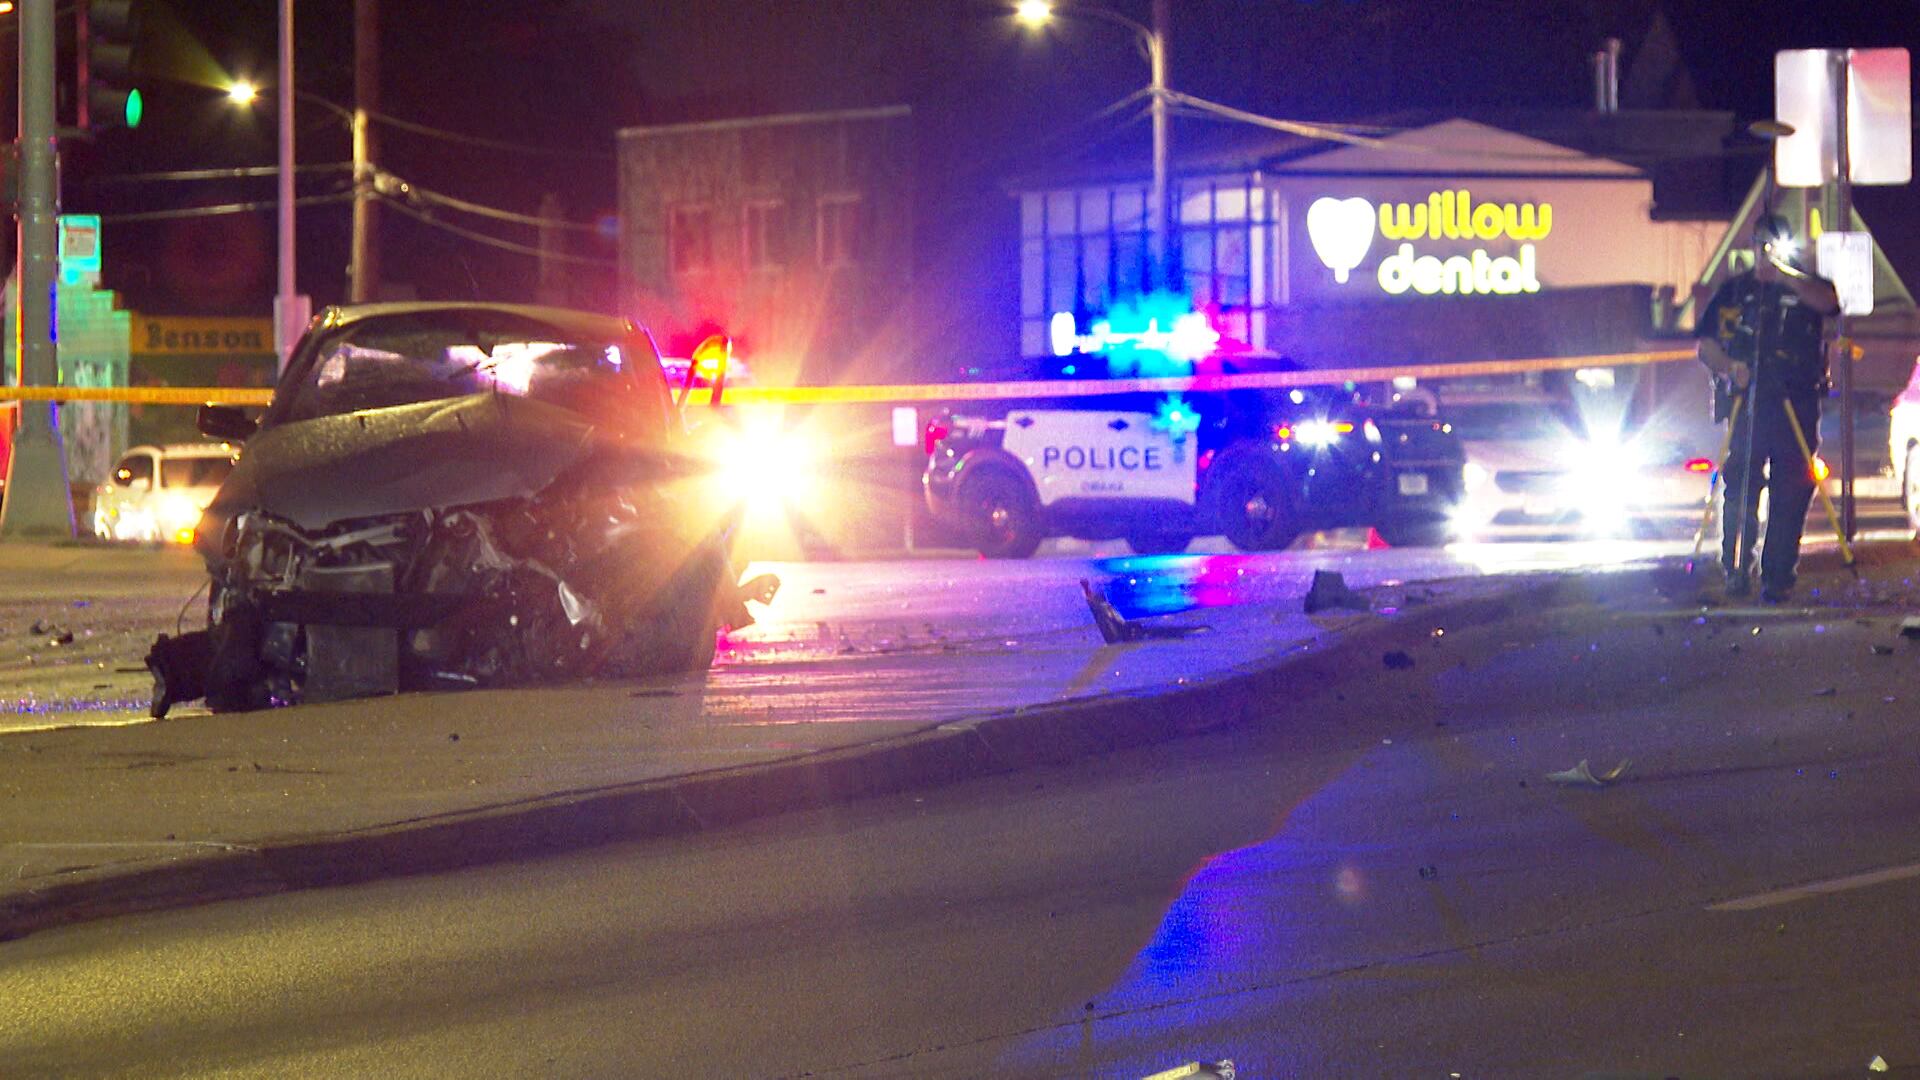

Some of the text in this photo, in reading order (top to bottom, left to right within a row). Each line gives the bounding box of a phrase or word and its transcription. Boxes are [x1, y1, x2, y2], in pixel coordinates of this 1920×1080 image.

[1379, 189, 1553, 240] willow
[1378, 243, 1541, 294] dental
[146, 321, 262, 348] Benson
[1043, 446, 1163, 470] POLICE
